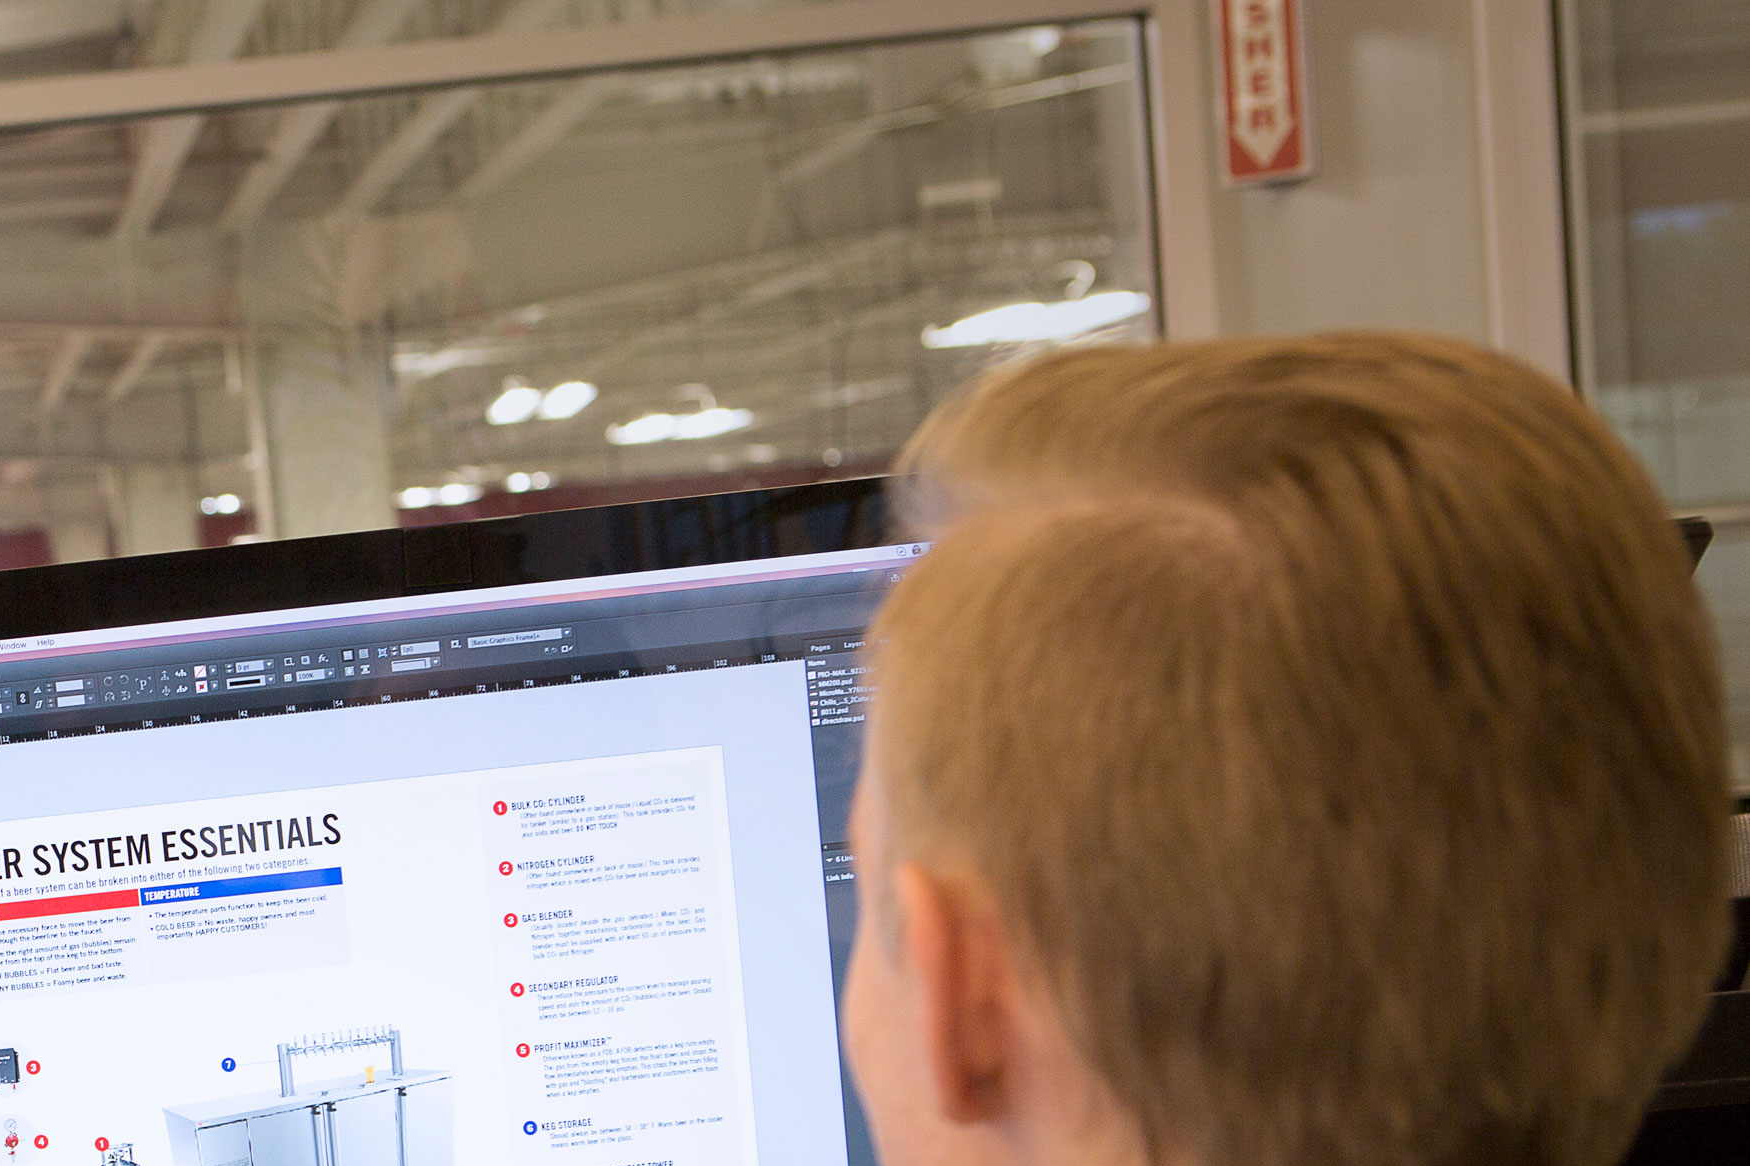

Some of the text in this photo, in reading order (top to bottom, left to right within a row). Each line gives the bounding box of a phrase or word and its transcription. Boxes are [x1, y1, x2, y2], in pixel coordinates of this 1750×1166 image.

[511, 801, 530, 811] BULK
[548, 795, 585, 807] CYLINDER
[32, 833, 151, 876] SYSTEM
[161, 813, 341, 862] ESSENTIALS
[517, 855, 594, 869] NITROGEN CYLINDER
[6, 889, 11, 897] a
[13, 887, 32, 896] beer
[35, 883, 65, 895] system
[68, 882, 84, 890] can
[85, 879, 96, 888] be
[98, 876, 128, 887] broken
[130, 874, 147, 883] into
[149, 871, 174, 881] either
[177, 868, 185, 878] of
[188, 868, 202, 877] the
[204, 865, 242, 875] following
[245, 863, 260, 871] two
[144, 886, 200, 901] TEMPERATURE
[522, 909, 572, 923] GAS BLENDER
[528, 975, 617, 993] SECONDARY REGULATOR
[534, 1042, 561, 1051] PROFIT
[541, 1118, 591, 1130] KEG STORAGE
